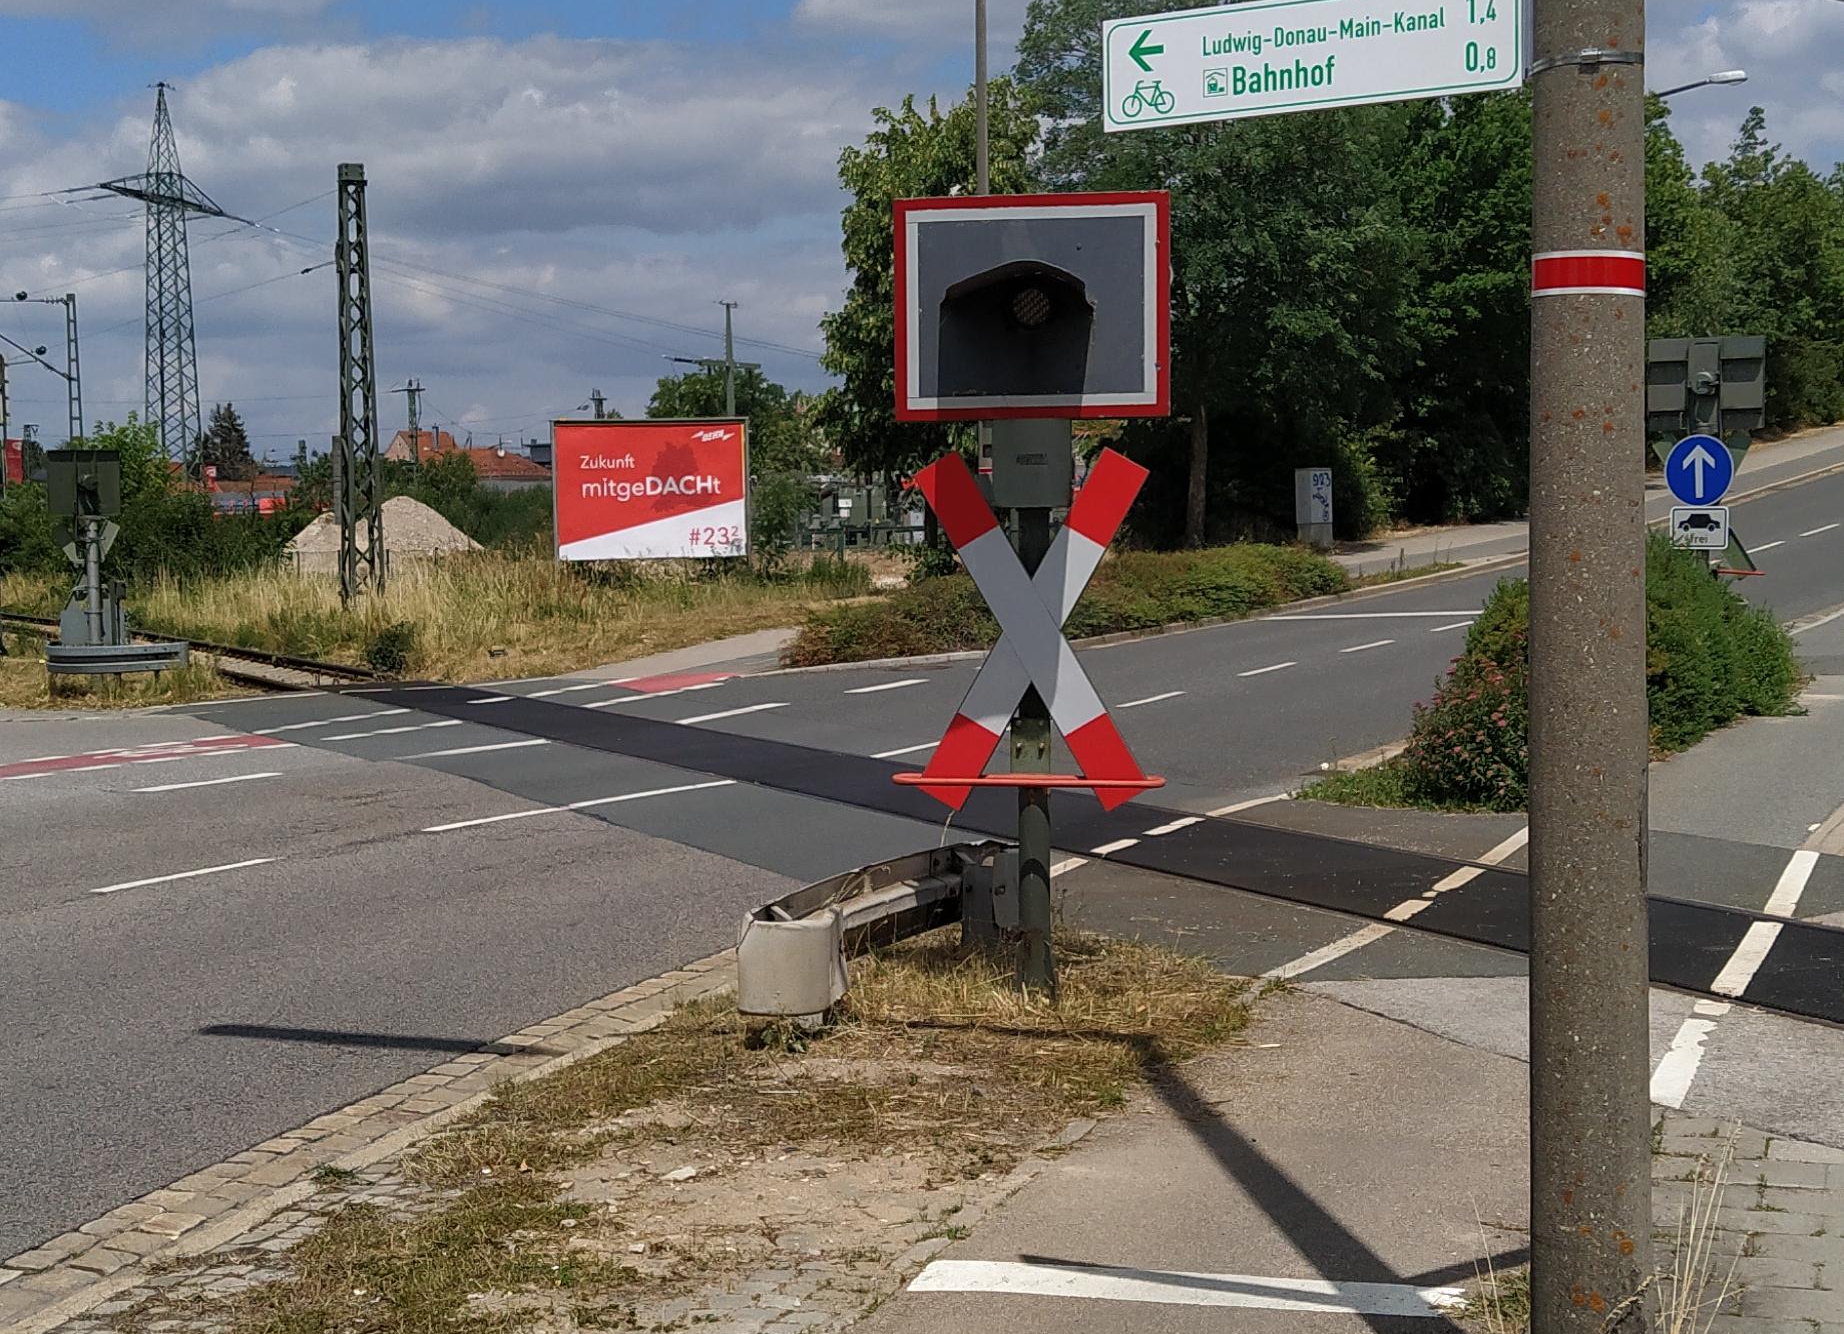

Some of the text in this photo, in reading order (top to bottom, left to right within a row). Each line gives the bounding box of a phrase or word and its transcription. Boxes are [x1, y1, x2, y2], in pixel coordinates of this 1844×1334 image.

[1202, 6, 1446, 57] Ludwig-Donau-Main-Kanal
[1232, 41, 1497, 96] Bahnhof 0,8
[580, 453, 635, 469] Zukunft
[582, 475, 721, 502] mitgeDACHt
